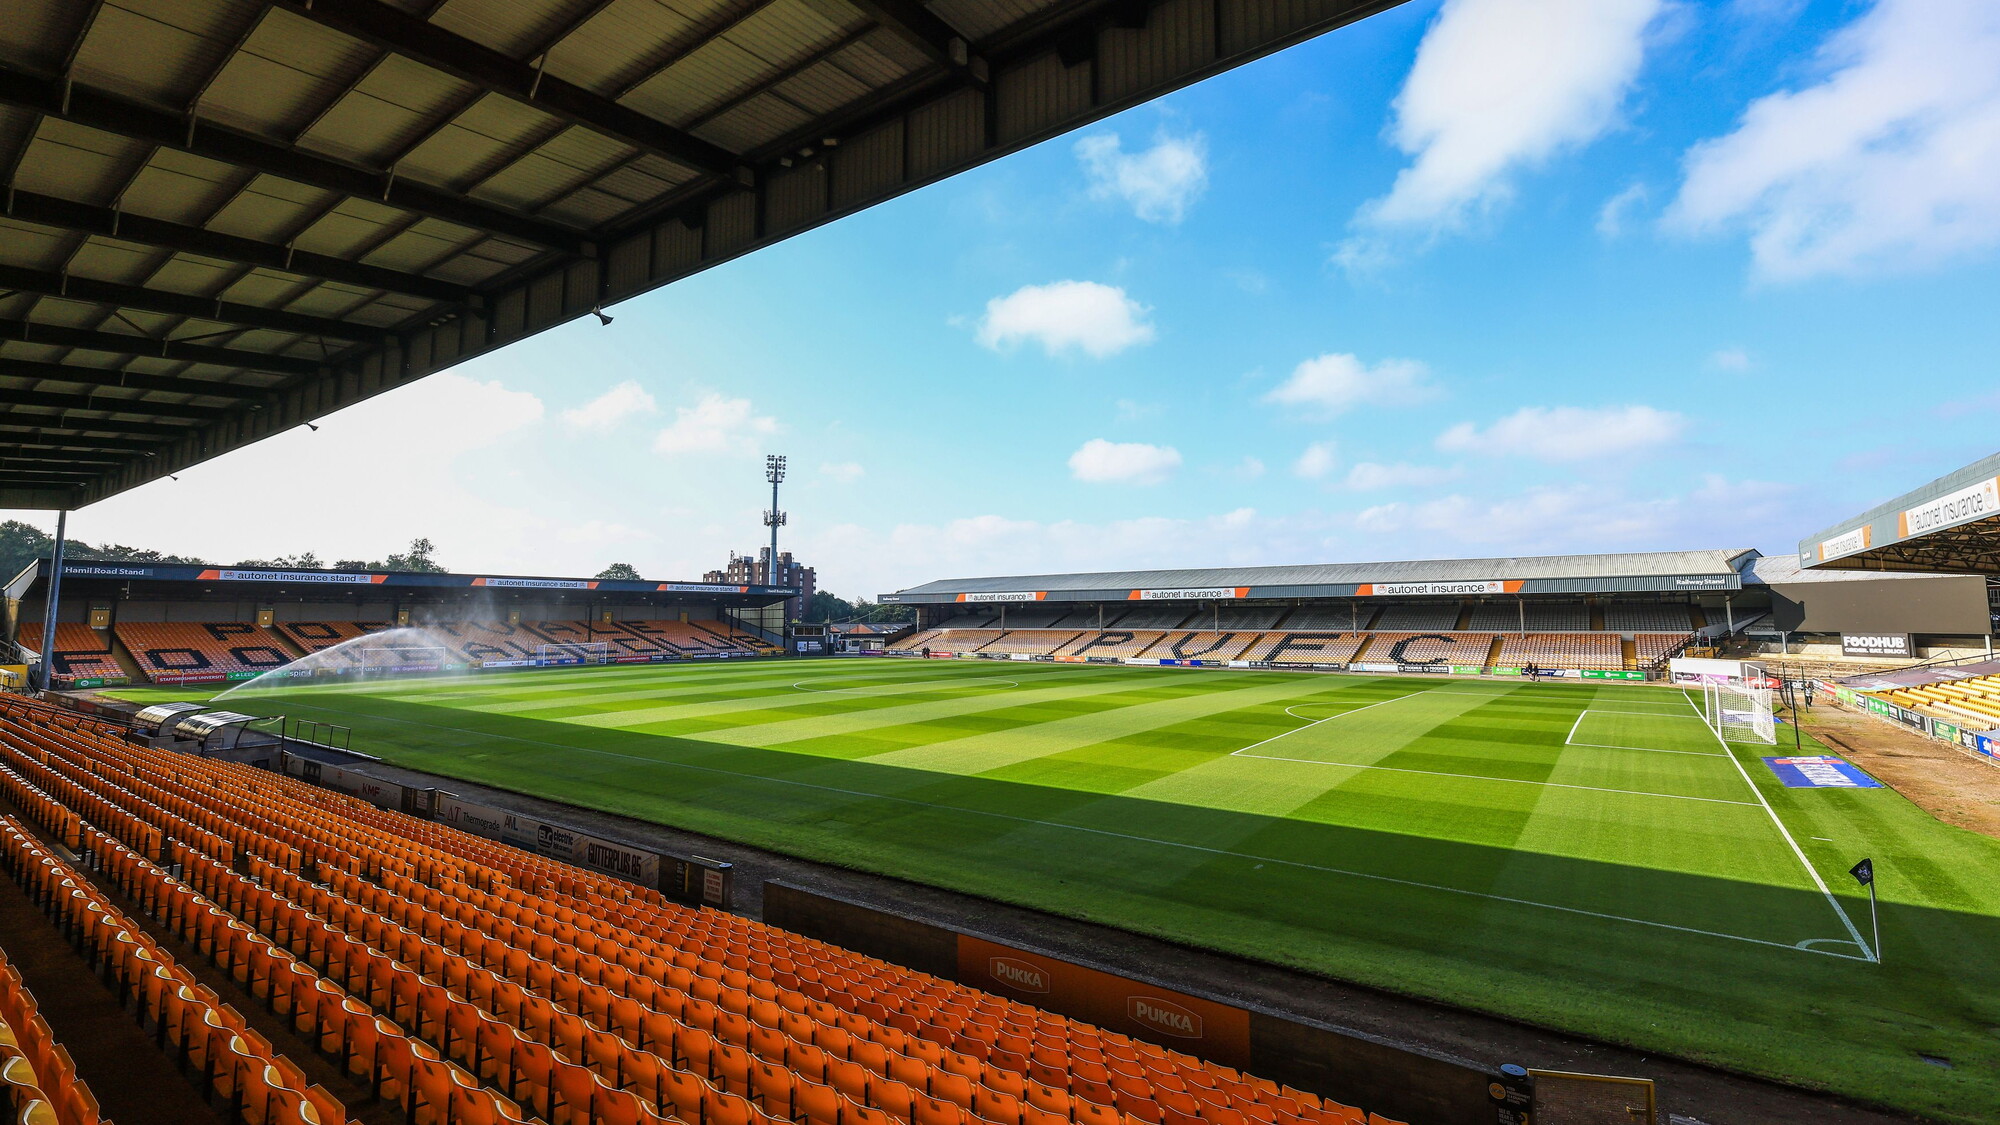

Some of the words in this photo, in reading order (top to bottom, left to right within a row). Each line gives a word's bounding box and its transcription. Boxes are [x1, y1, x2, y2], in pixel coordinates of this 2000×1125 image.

[1915, 508, 1941, 530] autonet
[1942, 493, 1983, 521] insurance
[94, 567, 118, 575] Road
[119, 568, 144, 576] Stand
[237, 572, 278, 580] autonet
[280, 573, 328, 582] insurance
[330, 574, 356, 582] stand
[1151, 590, 1181, 599] autonet
[1183, 589, 1222, 598] insurance
[1388, 585, 1428, 594] autonet
[1431, 583, 1485, 593] insurance
[997, 593, 1026, 601] insurance
[1843, 636, 1905, 648] FOODHUB
[362, 783, 380, 796] KMF
[463, 812, 500, 832] Thermograde
[503, 815, 519, 831] AML
[554, 830, 574, 846] electric
[587, 843, 631, 875] GUTTERPLUS
[631, 854, 642, 878] 85
[996, 961, 1043, 988] PUKKA
[1135, 1002, 1194, 1033] PUKKA
